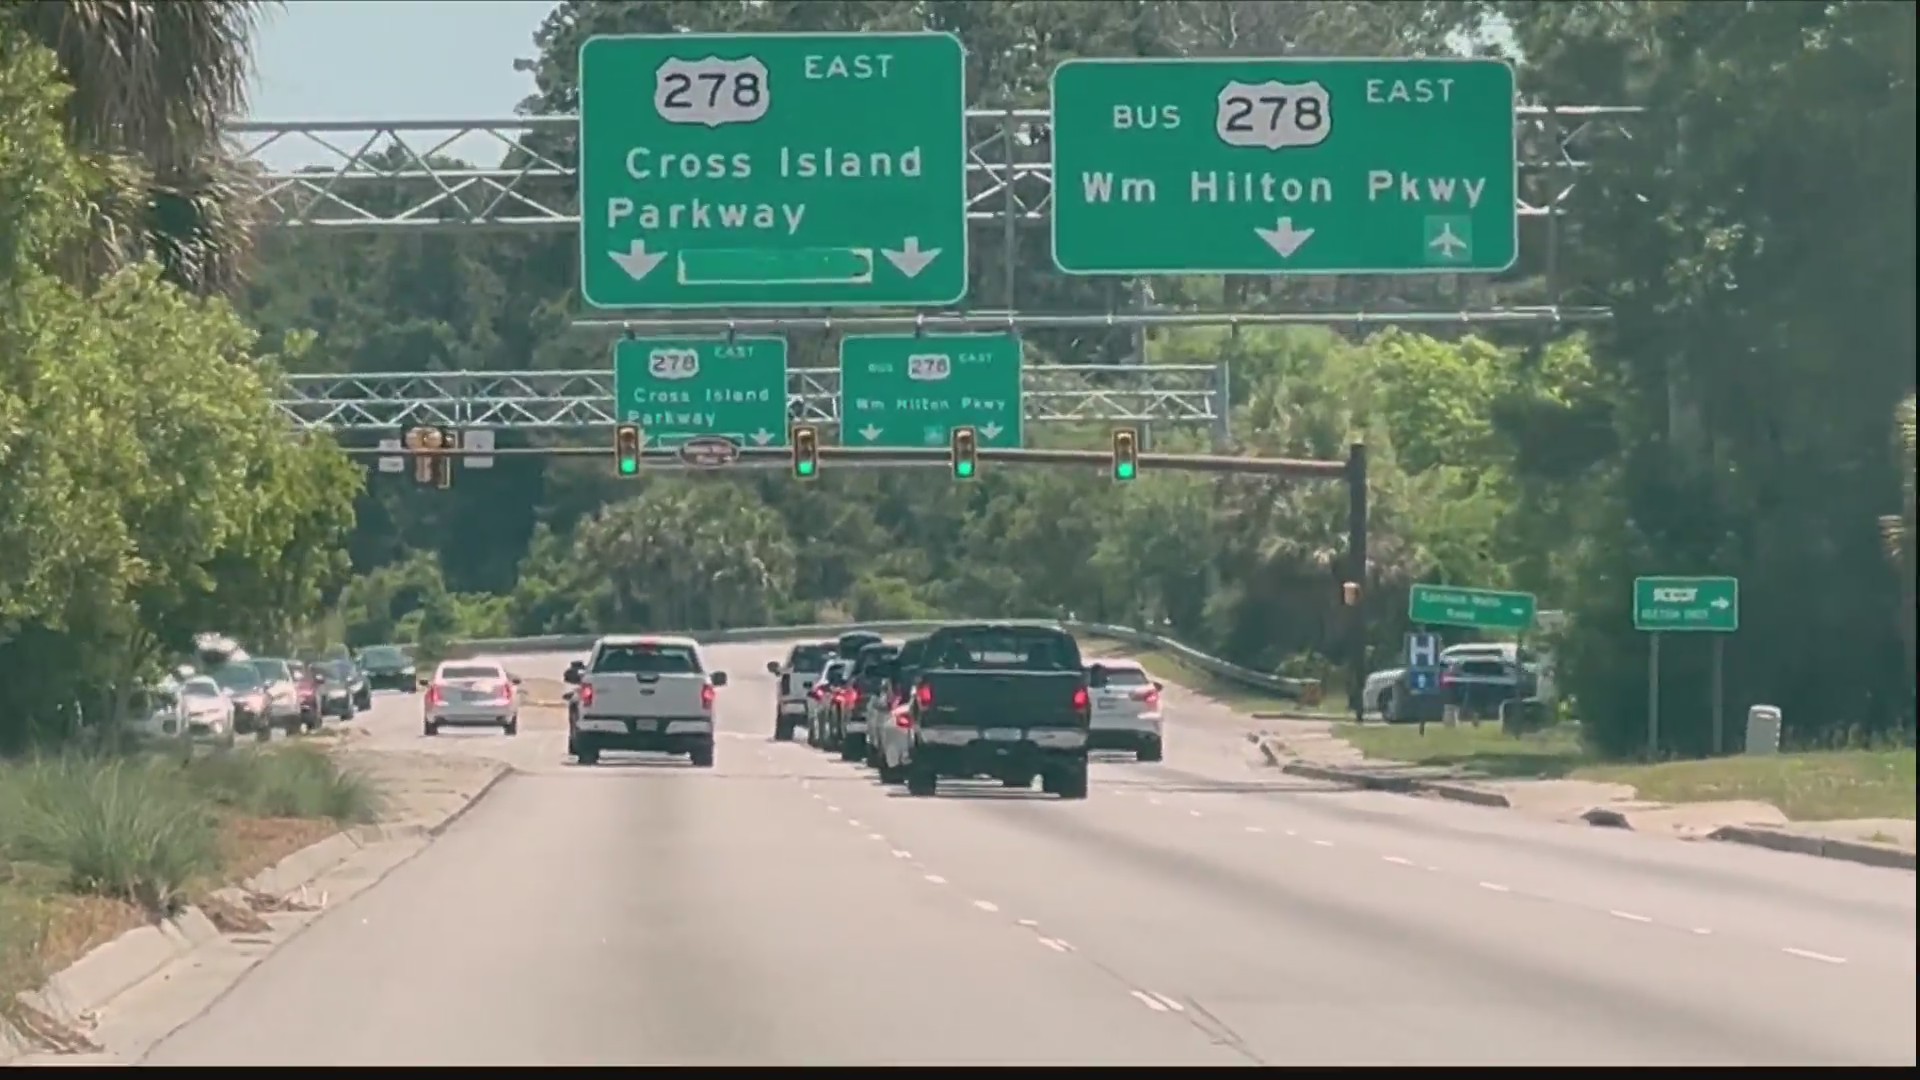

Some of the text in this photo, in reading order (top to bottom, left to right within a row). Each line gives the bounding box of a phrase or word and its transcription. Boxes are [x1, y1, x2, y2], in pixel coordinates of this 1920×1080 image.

[663, 54, 894, 108] 278 EAST
[1112, 78, 1455, 132] BUS 278 EAST
[626, 145, 922, 179] Cross Island
[1081, 170, 1487, 208] Wm Hilton Pkwy
[607, 197, 806, 235] Parkway
[652, 354, 696, 372] 278
[911, 358, 948, 375] 278
[958, 352, 993, 364] EAST
[633, 387, 769, 403] Cross Island
[856, 397, 1006, 411] Wm Hilton Pkwy
[627, 410, 716, 427] Parkway
[1410, 635, 1435, 666] H
